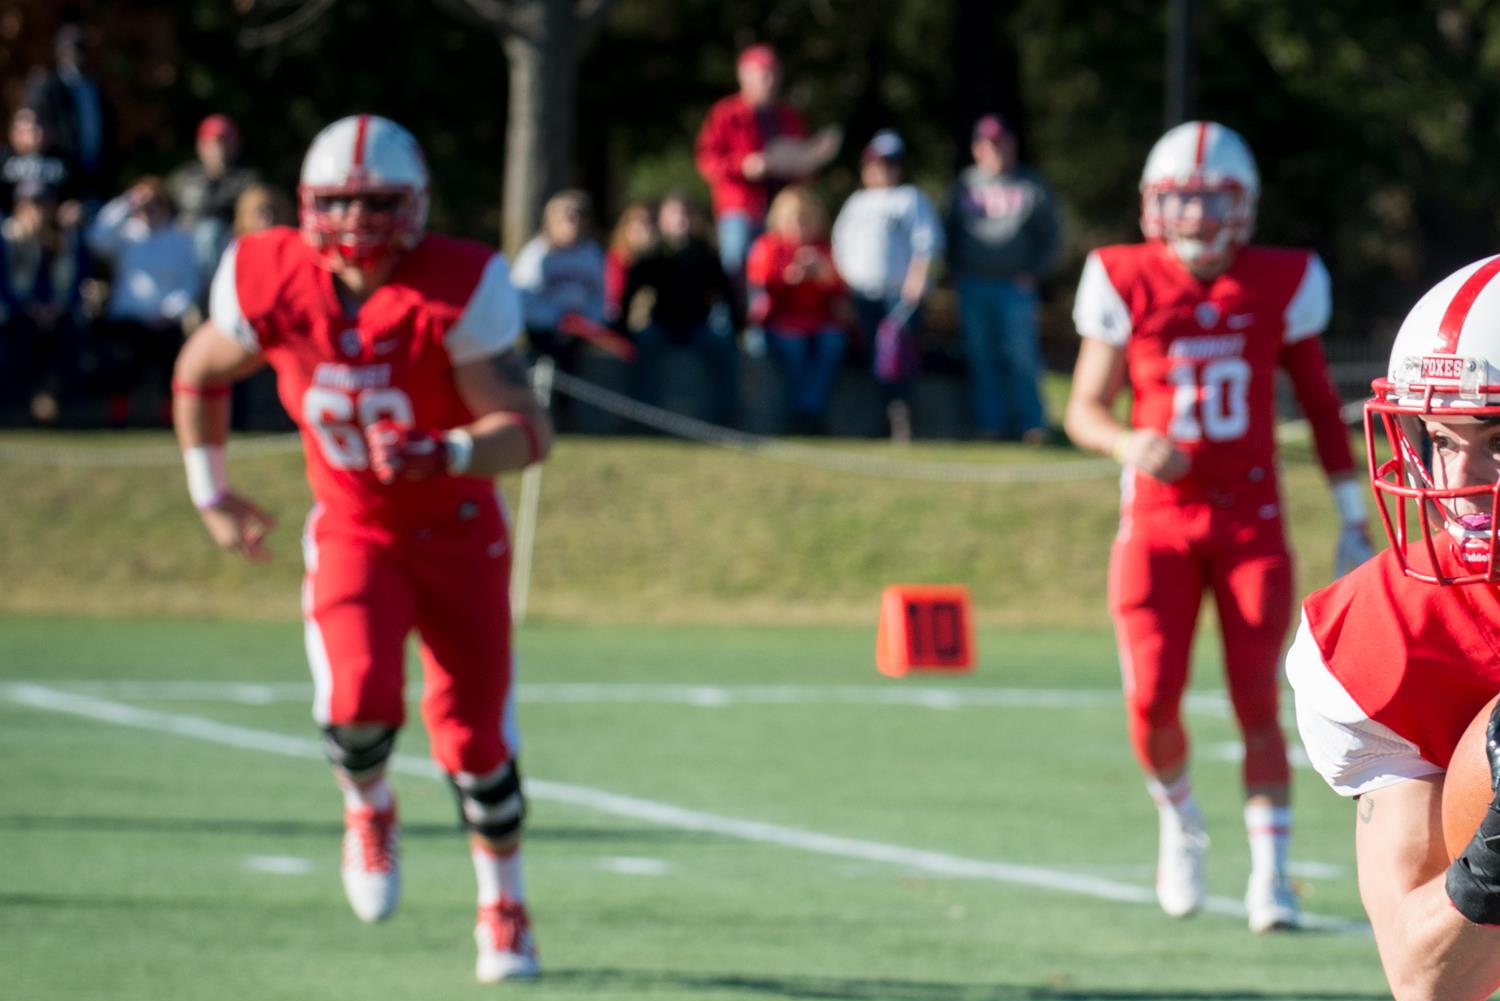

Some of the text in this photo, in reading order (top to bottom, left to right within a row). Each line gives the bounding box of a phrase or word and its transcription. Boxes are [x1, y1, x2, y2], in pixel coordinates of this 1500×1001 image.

[1422, 358, 1463, 378] FOXES
[1166, 357, 1252, 442] 10
[907, 601, 961, 661] 10
